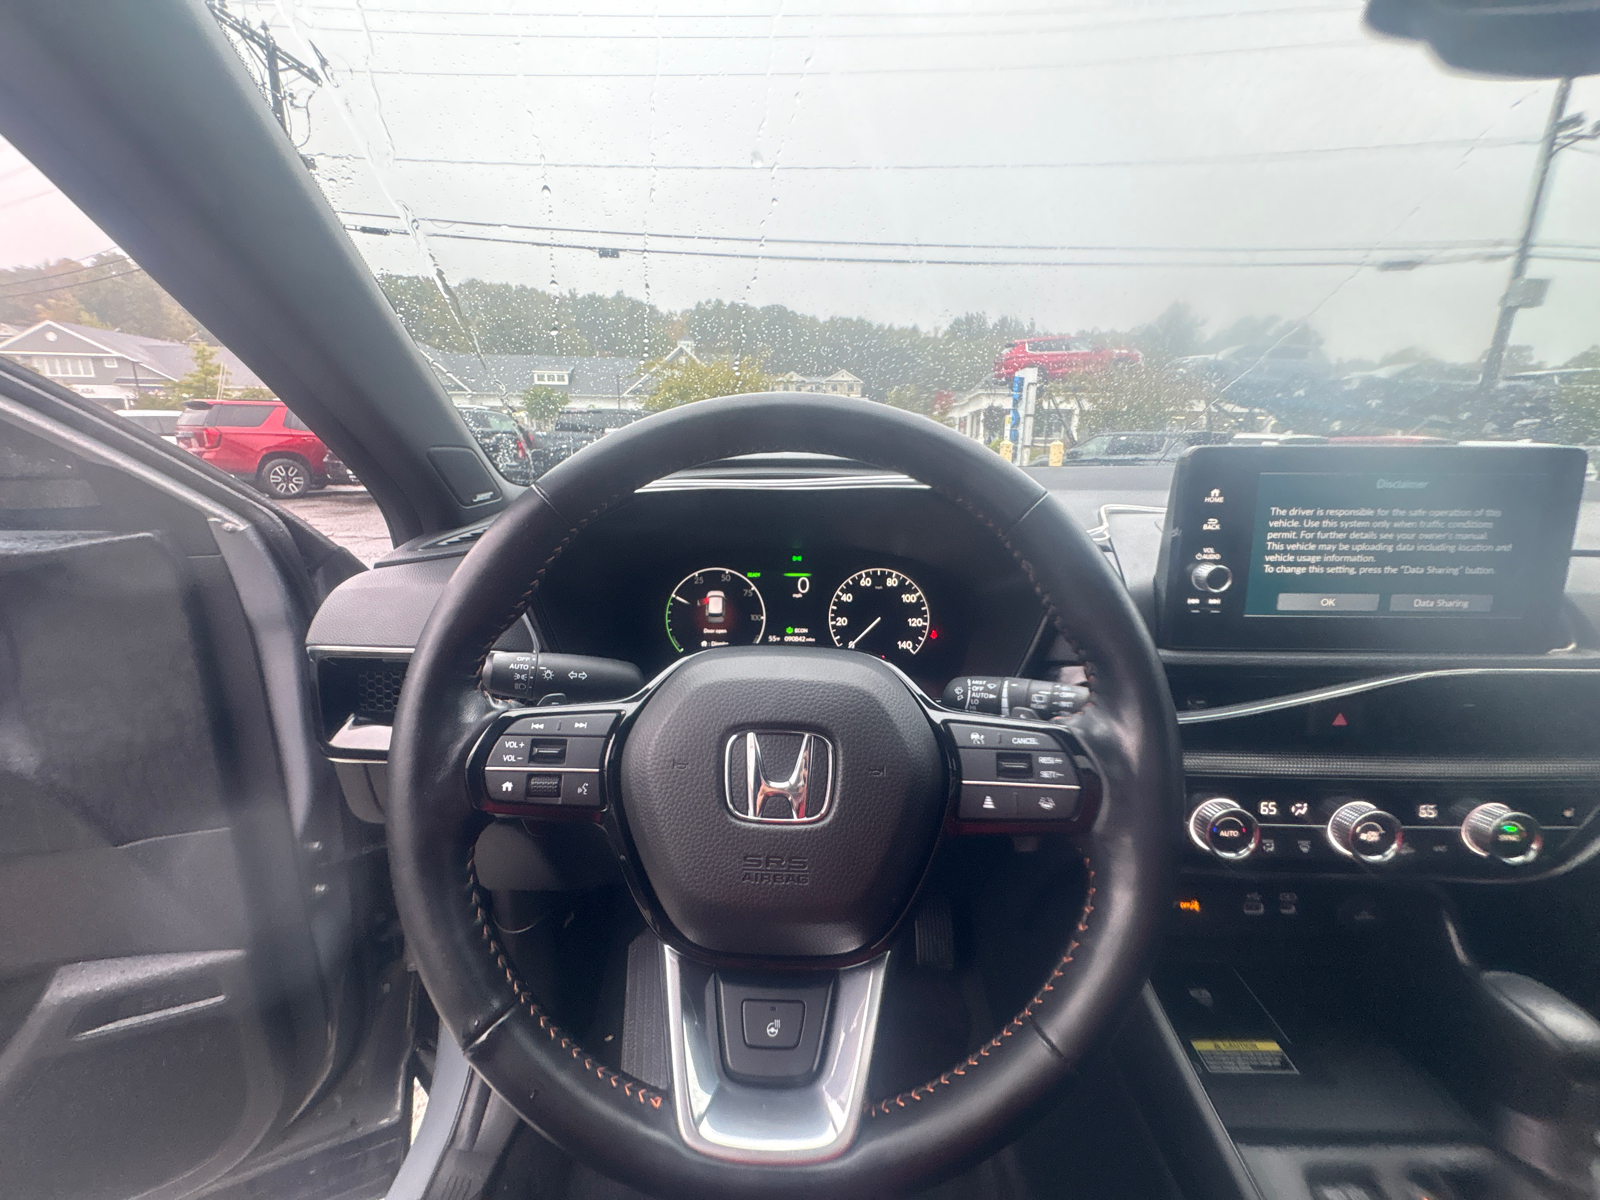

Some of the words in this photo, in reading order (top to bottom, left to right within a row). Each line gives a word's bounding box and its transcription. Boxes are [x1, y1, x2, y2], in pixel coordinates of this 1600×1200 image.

[1270, 507, 1287, 516] The
[1288, 507, 1314, 516] driver
[1316, 507, 1324, 516] is
[1326, 508, 1374, 517] responsible
[1376, 508, 1390, 517] for
[1391, 508, 1406, 517] the
[1408, 508, 1427, 517] safe
[1428, 509, 1472, 518] operation
[1474, 508, 1485, 517] of
[1268, 519, 1301, 528] vehicle.
[1303, 519, 1320, 528] Use
[1322, 519, 1338, 528] this
[1340, 520, 1370, 529] system
[1372, 520, 1390, 529] only
[1393, 520, 1418, 528] when
[1419, 520, 1446, 528] traffic
[1448, 520, 1494, 528] conditions
[1266, 530, 1298, 540] permit.
[1300, 530, 1315, 540] For
[1316, 530, 1346, 540] further
[1349, 531, 1378, 540] details
[1396, 533, 1416, 541] your
[1266, 542, 1284, 550] This
[1286, 542, 1316, 550] vehicle
[1318, 543, 1337, 552] may
[1338, 542, 1350, 550] be
[1352, 543, 1394, 552] uploading
[1396, 543, 1414, 551] data
[1416, 543, 1456, 553] including
[1458, 544, 1494, 552] location
[1495, 544, 1512, 552] and
[1264, 554, 1294, 562] vehicle
[1296, 555, 1322, 564] usage
[1324, 554, 1376, 562] information.
[1263, 564, 1274, 573] To
[1276, 564, 1306, 574] change
[1308, 565, 1324, 574] this
[1326, 565, 1357, 575] setting,
[1359, 566, 1382, 575] press
[1384, 565, 1398, 574] the
[694, 576, 704, 584] 25
[860, 578, 872, 586] 60
[886, 578, 898, 587] 80
[797, 577, 810, 593] 0
[743, 589, 753, 597] 75
[841, 593, 853, 602] 40
[901, 594, 916, 603] 100
[1320, 598, 1336, 606] OK
[1414, 599, 1434, 607] Data
[1436, 599, 1469, 608] Sharing
[836, 617, 848, 626] 20
[908, 618, 922, 627] 120
[897, 641, 912, 649] 140
[1260, 802, 1277, 815] 65
[1419, 804, 1438, 818] 65
[742, 856, 808, 870] SRS
[742, 872, 809, 885] AIRBAG
